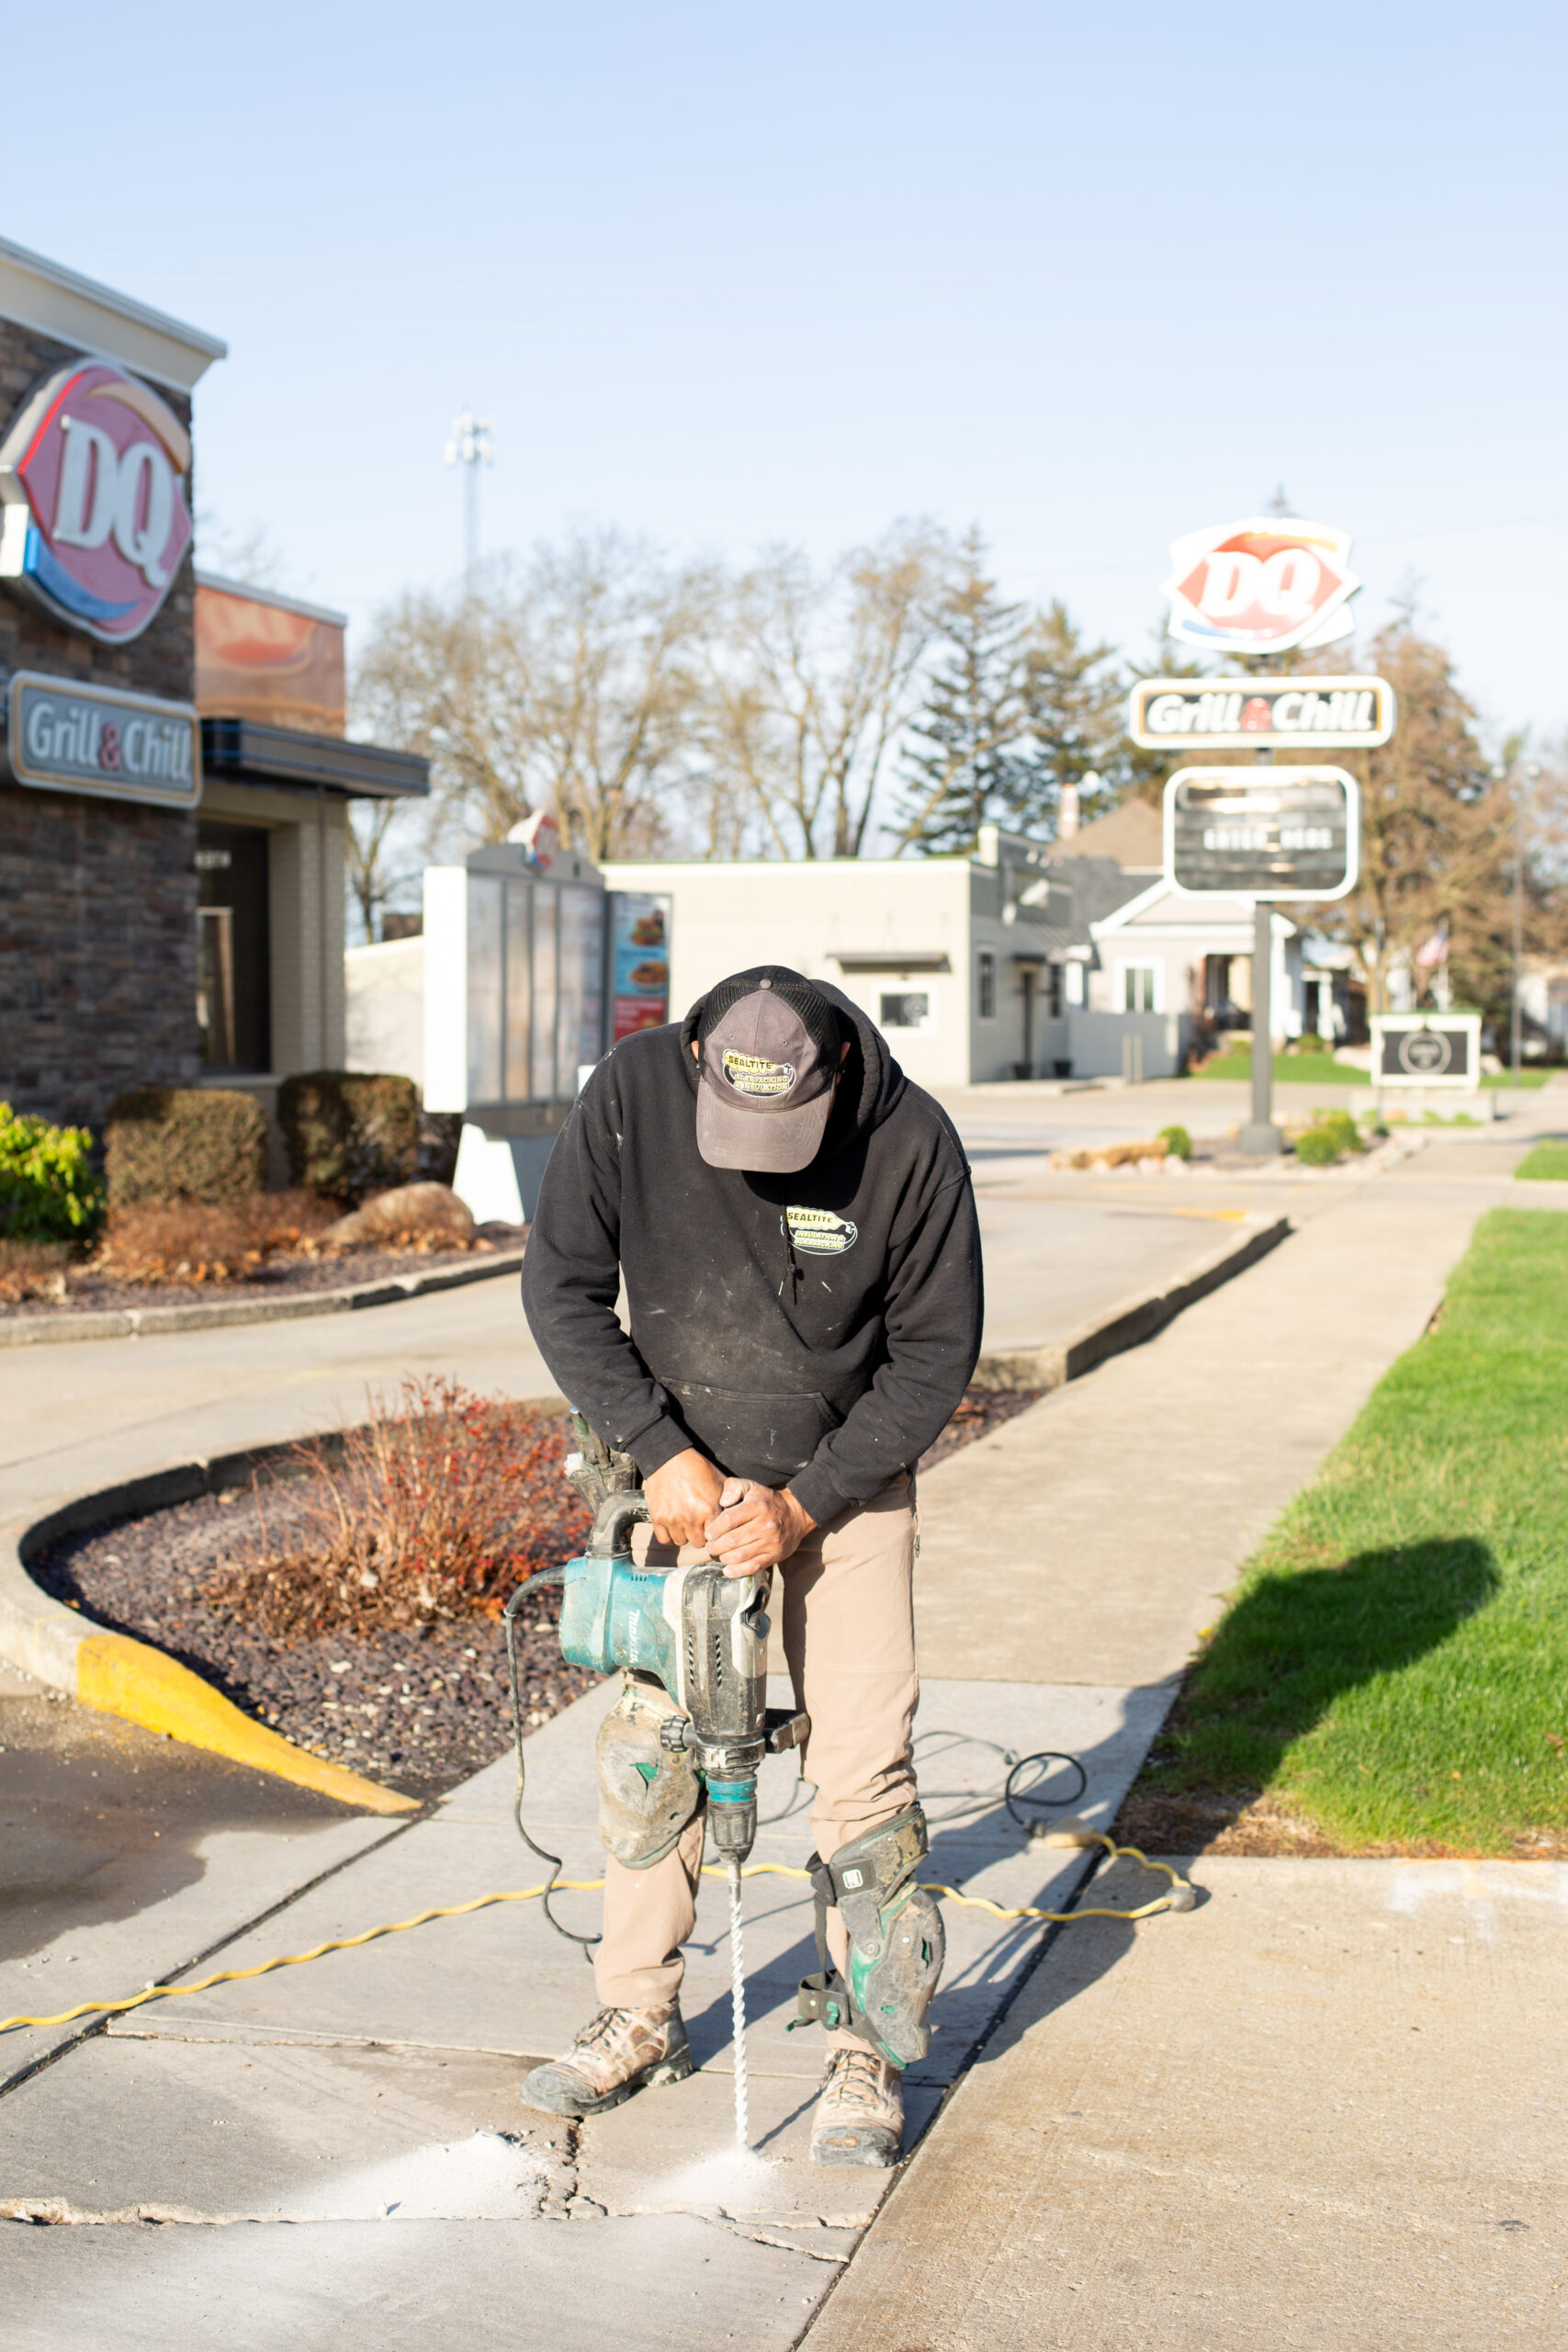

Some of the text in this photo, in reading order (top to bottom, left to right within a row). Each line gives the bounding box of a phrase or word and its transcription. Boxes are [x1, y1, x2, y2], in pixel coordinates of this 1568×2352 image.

[52, 414, 175, 589] DQ
[1197, 548, 1320, 620] DQ
[728, 1056, 772, 1069] SEALTITE
[787, 1212, 833, 1223] SEALTITE
